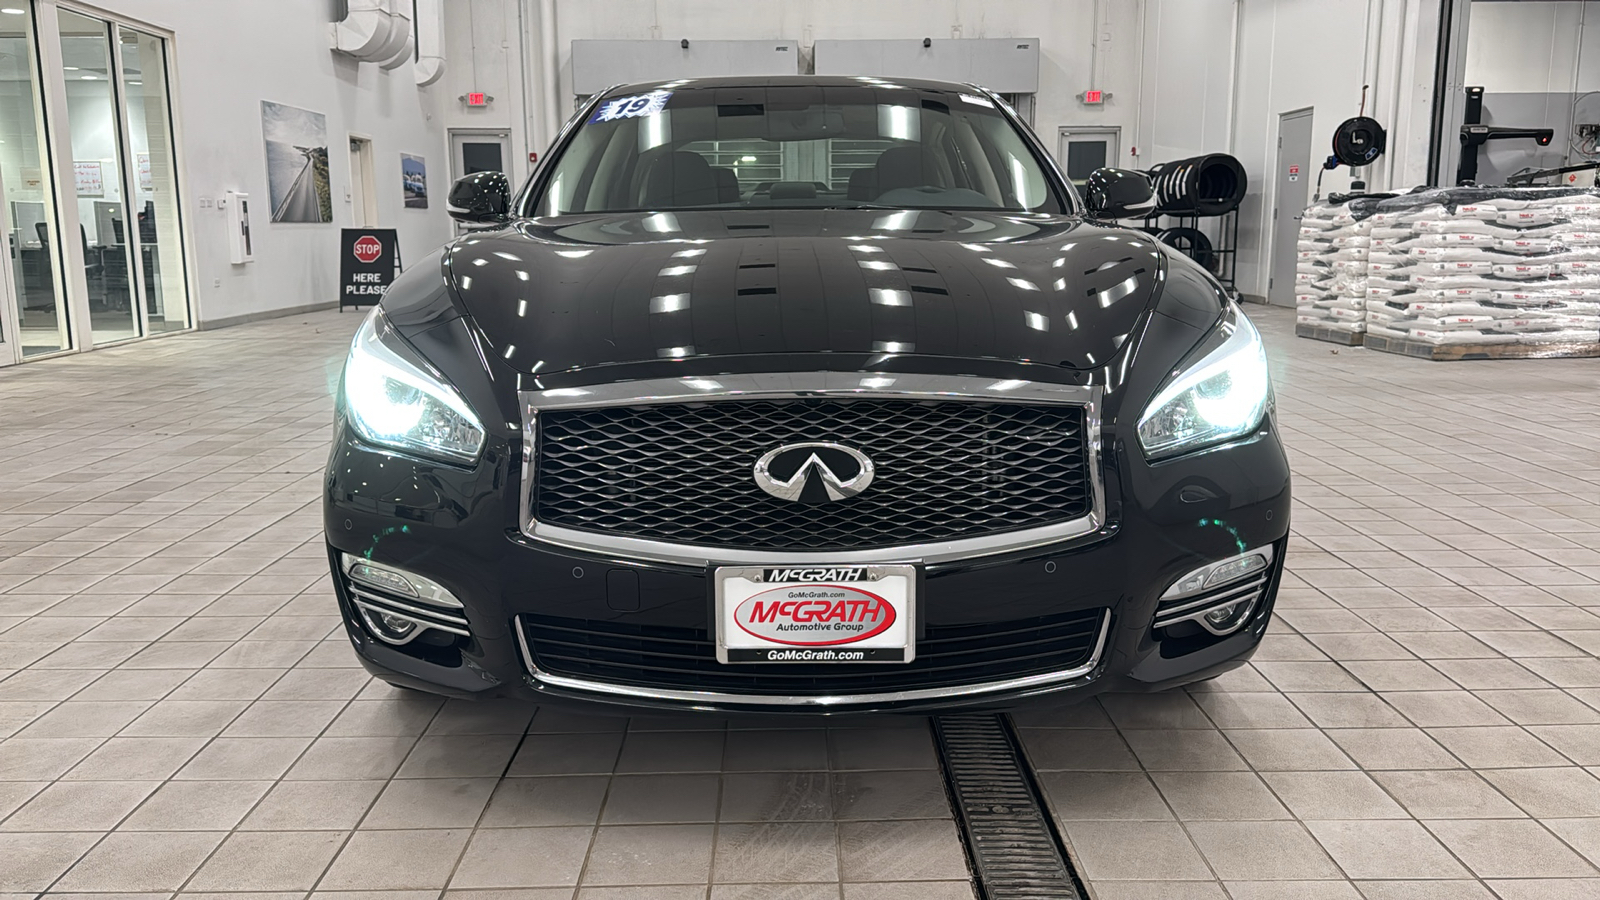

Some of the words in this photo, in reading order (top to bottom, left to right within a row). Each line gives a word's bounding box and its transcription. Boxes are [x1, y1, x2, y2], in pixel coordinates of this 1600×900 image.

[615, 98, 651, 115] 19
[355, 244, 380, 254] STOP
[353, 273, 381, 282] HERE
[346, 285, 387, 295] PLEASE
[787, 591, 846, 599] GoMcGrath.com
[776, 623, 831, 632] Automotive
[833, 623, 864, 632] Group
[767, 650, 864, 661] GoMcGrath.com
